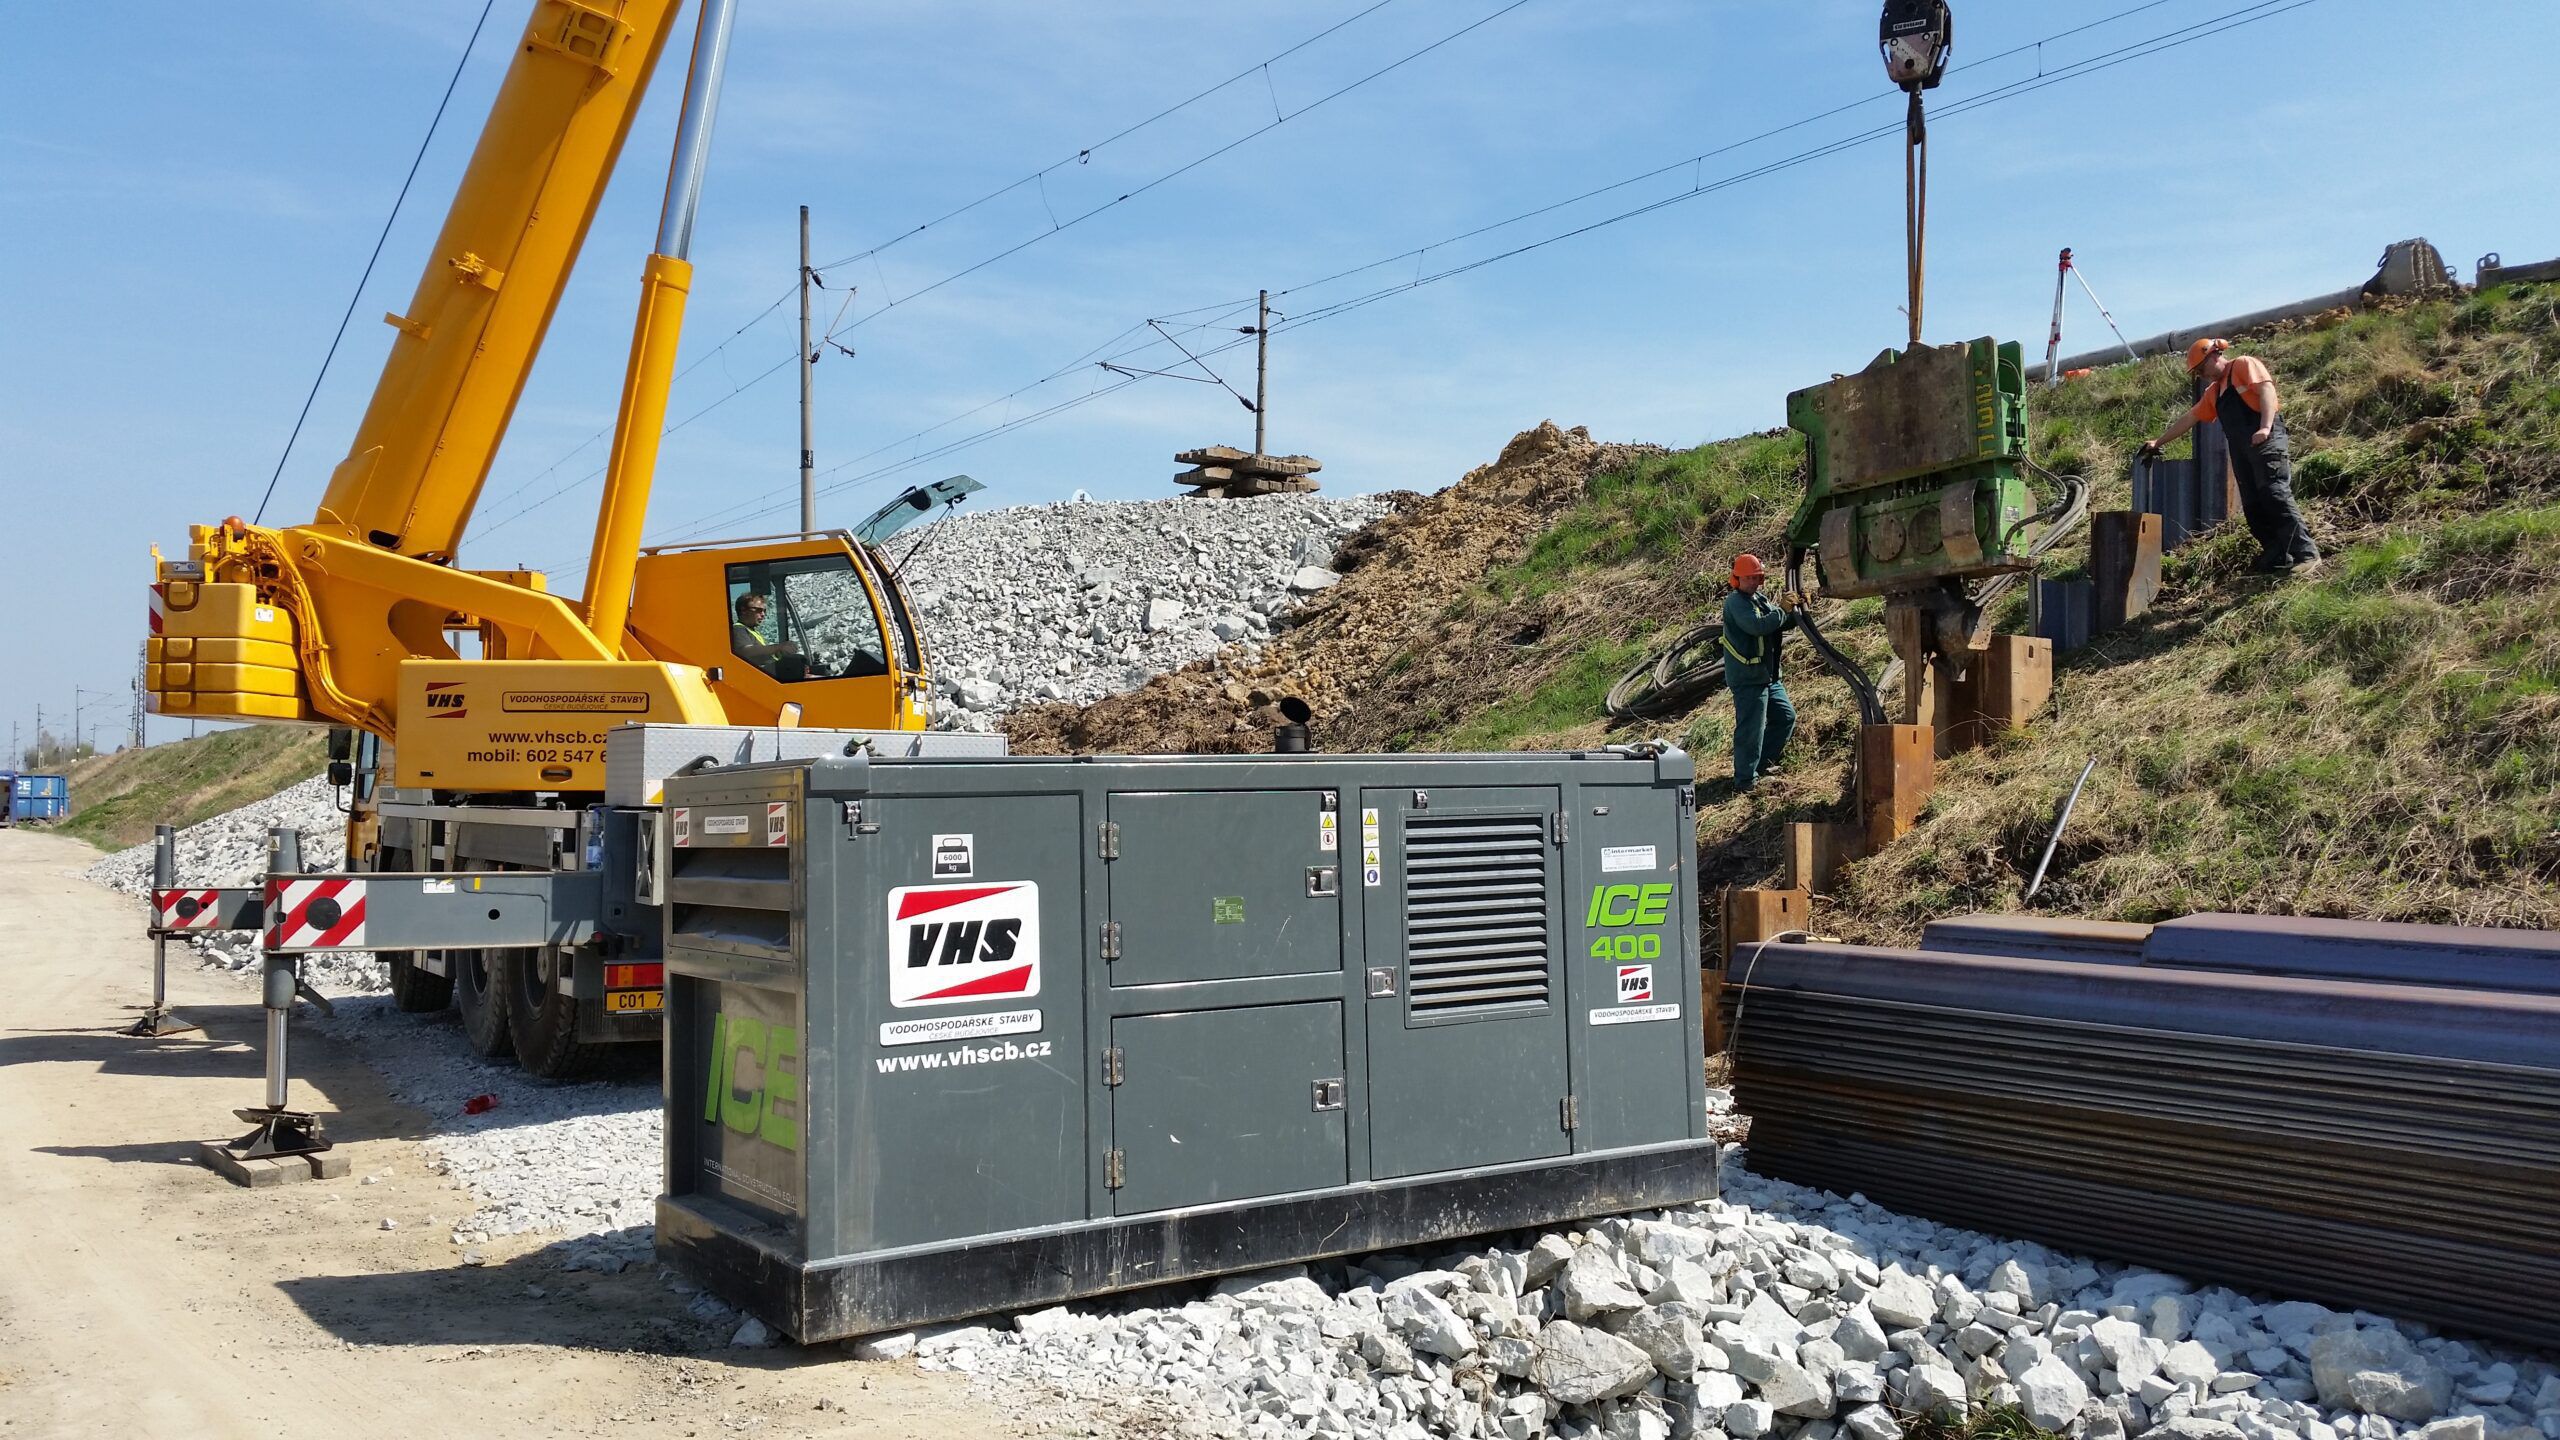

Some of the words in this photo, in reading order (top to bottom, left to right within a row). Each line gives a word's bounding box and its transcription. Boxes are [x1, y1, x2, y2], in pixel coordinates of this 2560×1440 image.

[427, 694, 465, 707] VHS
[510, 693, 605, 703] VODOHOSPODÁŘSKÉ
[610, 695, 645, 703] STAVBY
[467, 749, 520, 762] mobil:
[526, 749, 557, 763] 602
[563, 750, 594, 762] 547
[676, 821, 688, 835] VHS
[769, 816, 784, 833] VHS
[948, 863, 957, 872] kg
[1586, 883, 1673, 927] ICE
[907, 918, 1022, 968] VHS
[1590, 933, 1661, 961] 400
[1621, 977, 1649, 991] VHS
[1000, 1013, 1034, 1025] STAVBY
[876, 1041, 1052, 1074] www.vhscb.cz
[704, 1012, 796, 1151] ICE
